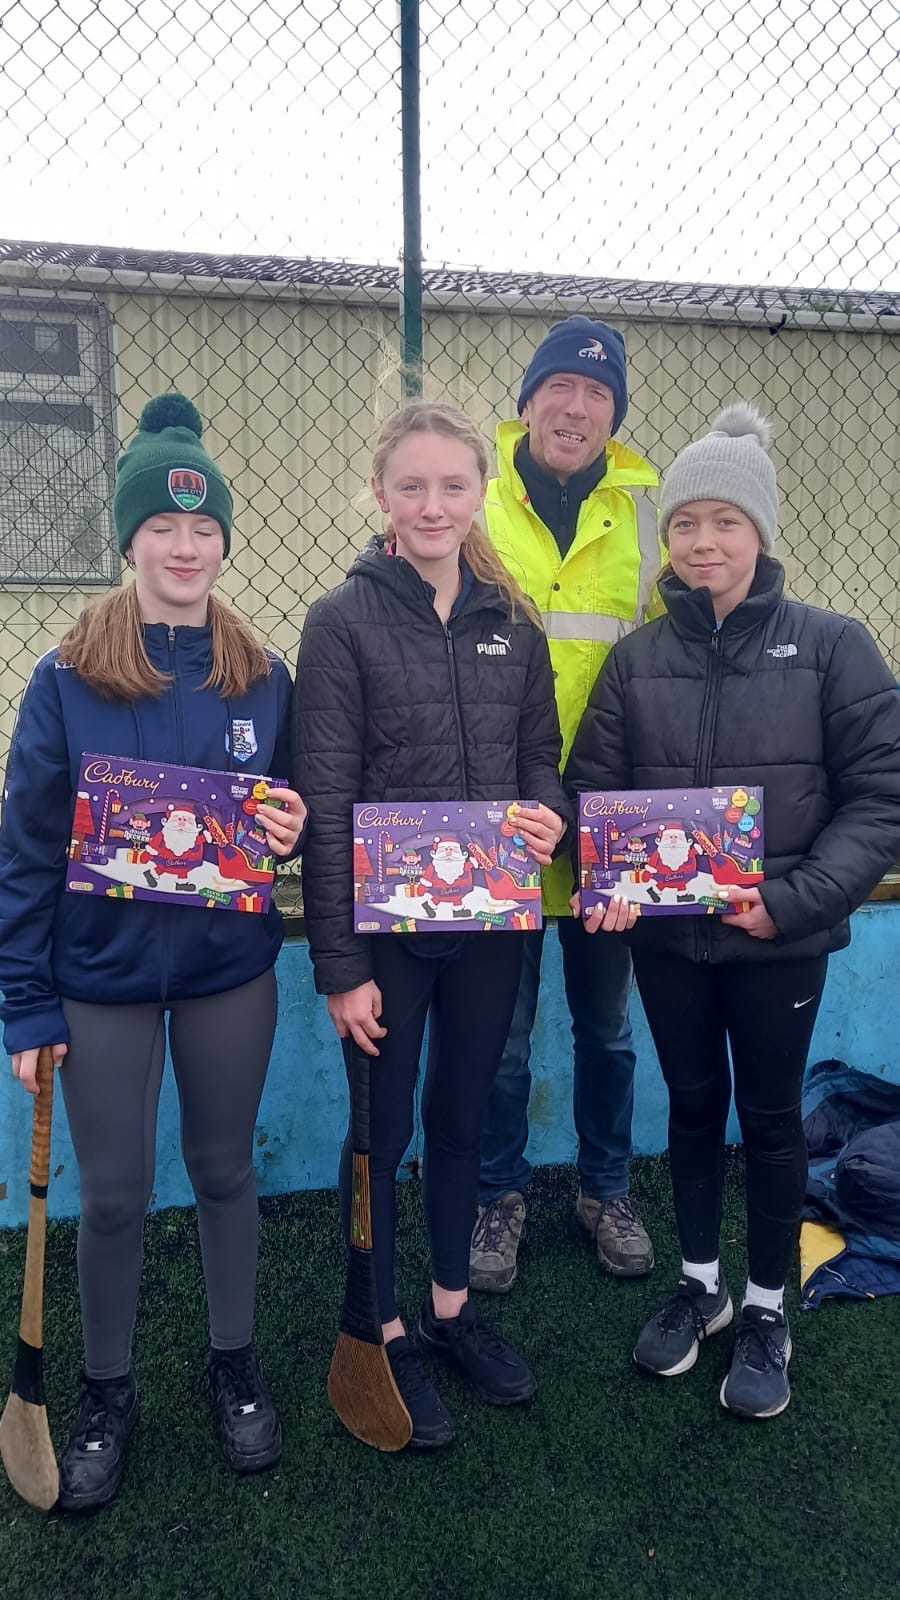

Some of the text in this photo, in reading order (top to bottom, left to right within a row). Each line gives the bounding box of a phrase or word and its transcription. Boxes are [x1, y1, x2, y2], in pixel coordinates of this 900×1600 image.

[578, 350, 607, 361] CMP
[476, 643, 507, 656] PUMA
[84, 760, 160, 795] Cadbury
[357, 806, 423, 831] Cadbury
[583, 795, 649, 819] Cadbury
